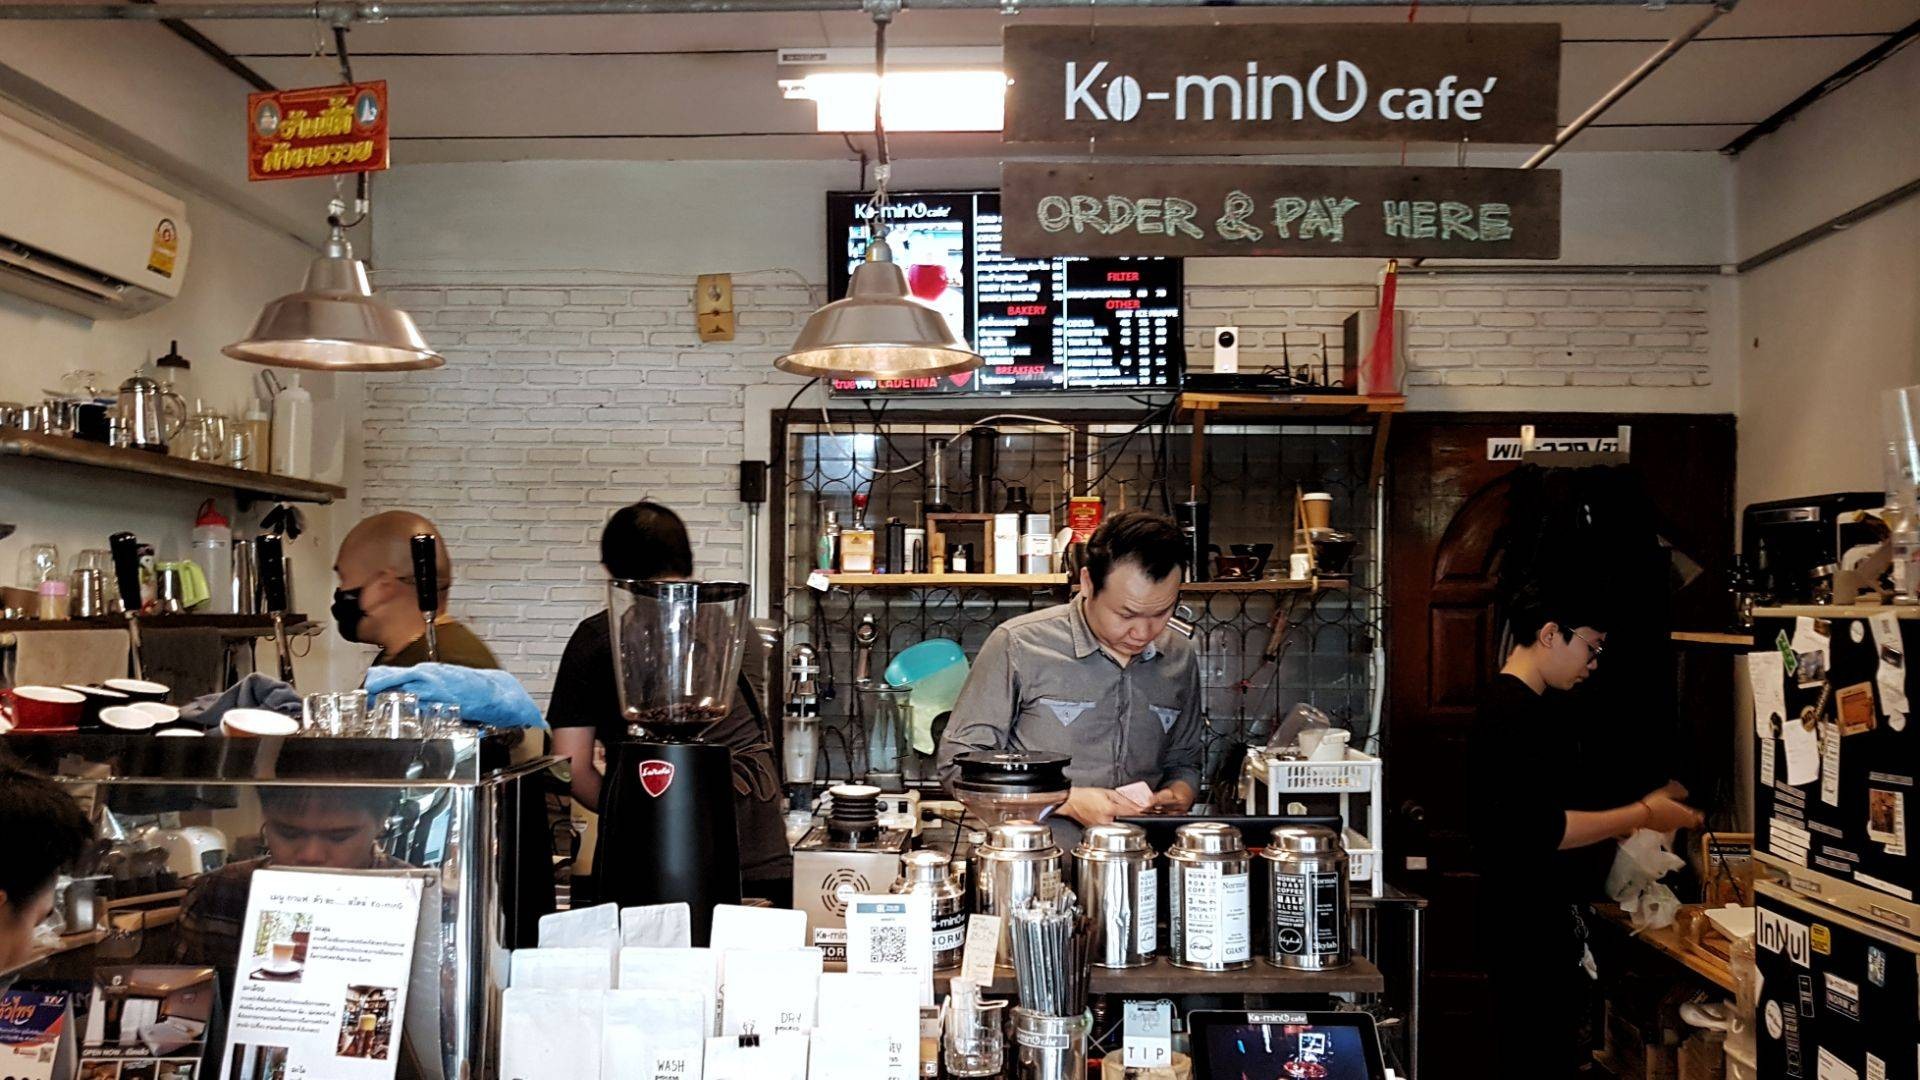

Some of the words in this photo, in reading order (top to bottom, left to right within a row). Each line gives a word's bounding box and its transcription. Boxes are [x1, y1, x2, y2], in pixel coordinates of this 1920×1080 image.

[1037, 194, 1205, 240] ORDER
[1215, 189, 1264, 242] &
[1274, 196, 1361, 242] PAY
[1383, 199, 1514, 242] HERE
[1107, 272, 1140, 282] FILTER
[1105, 299, 1141, 309] OTHER
[1007, 305, 1047, 316] BAKERY
[995, 365, 1045, 375] BREAKFAST
[657, 1059, 685, 1072] WASH
